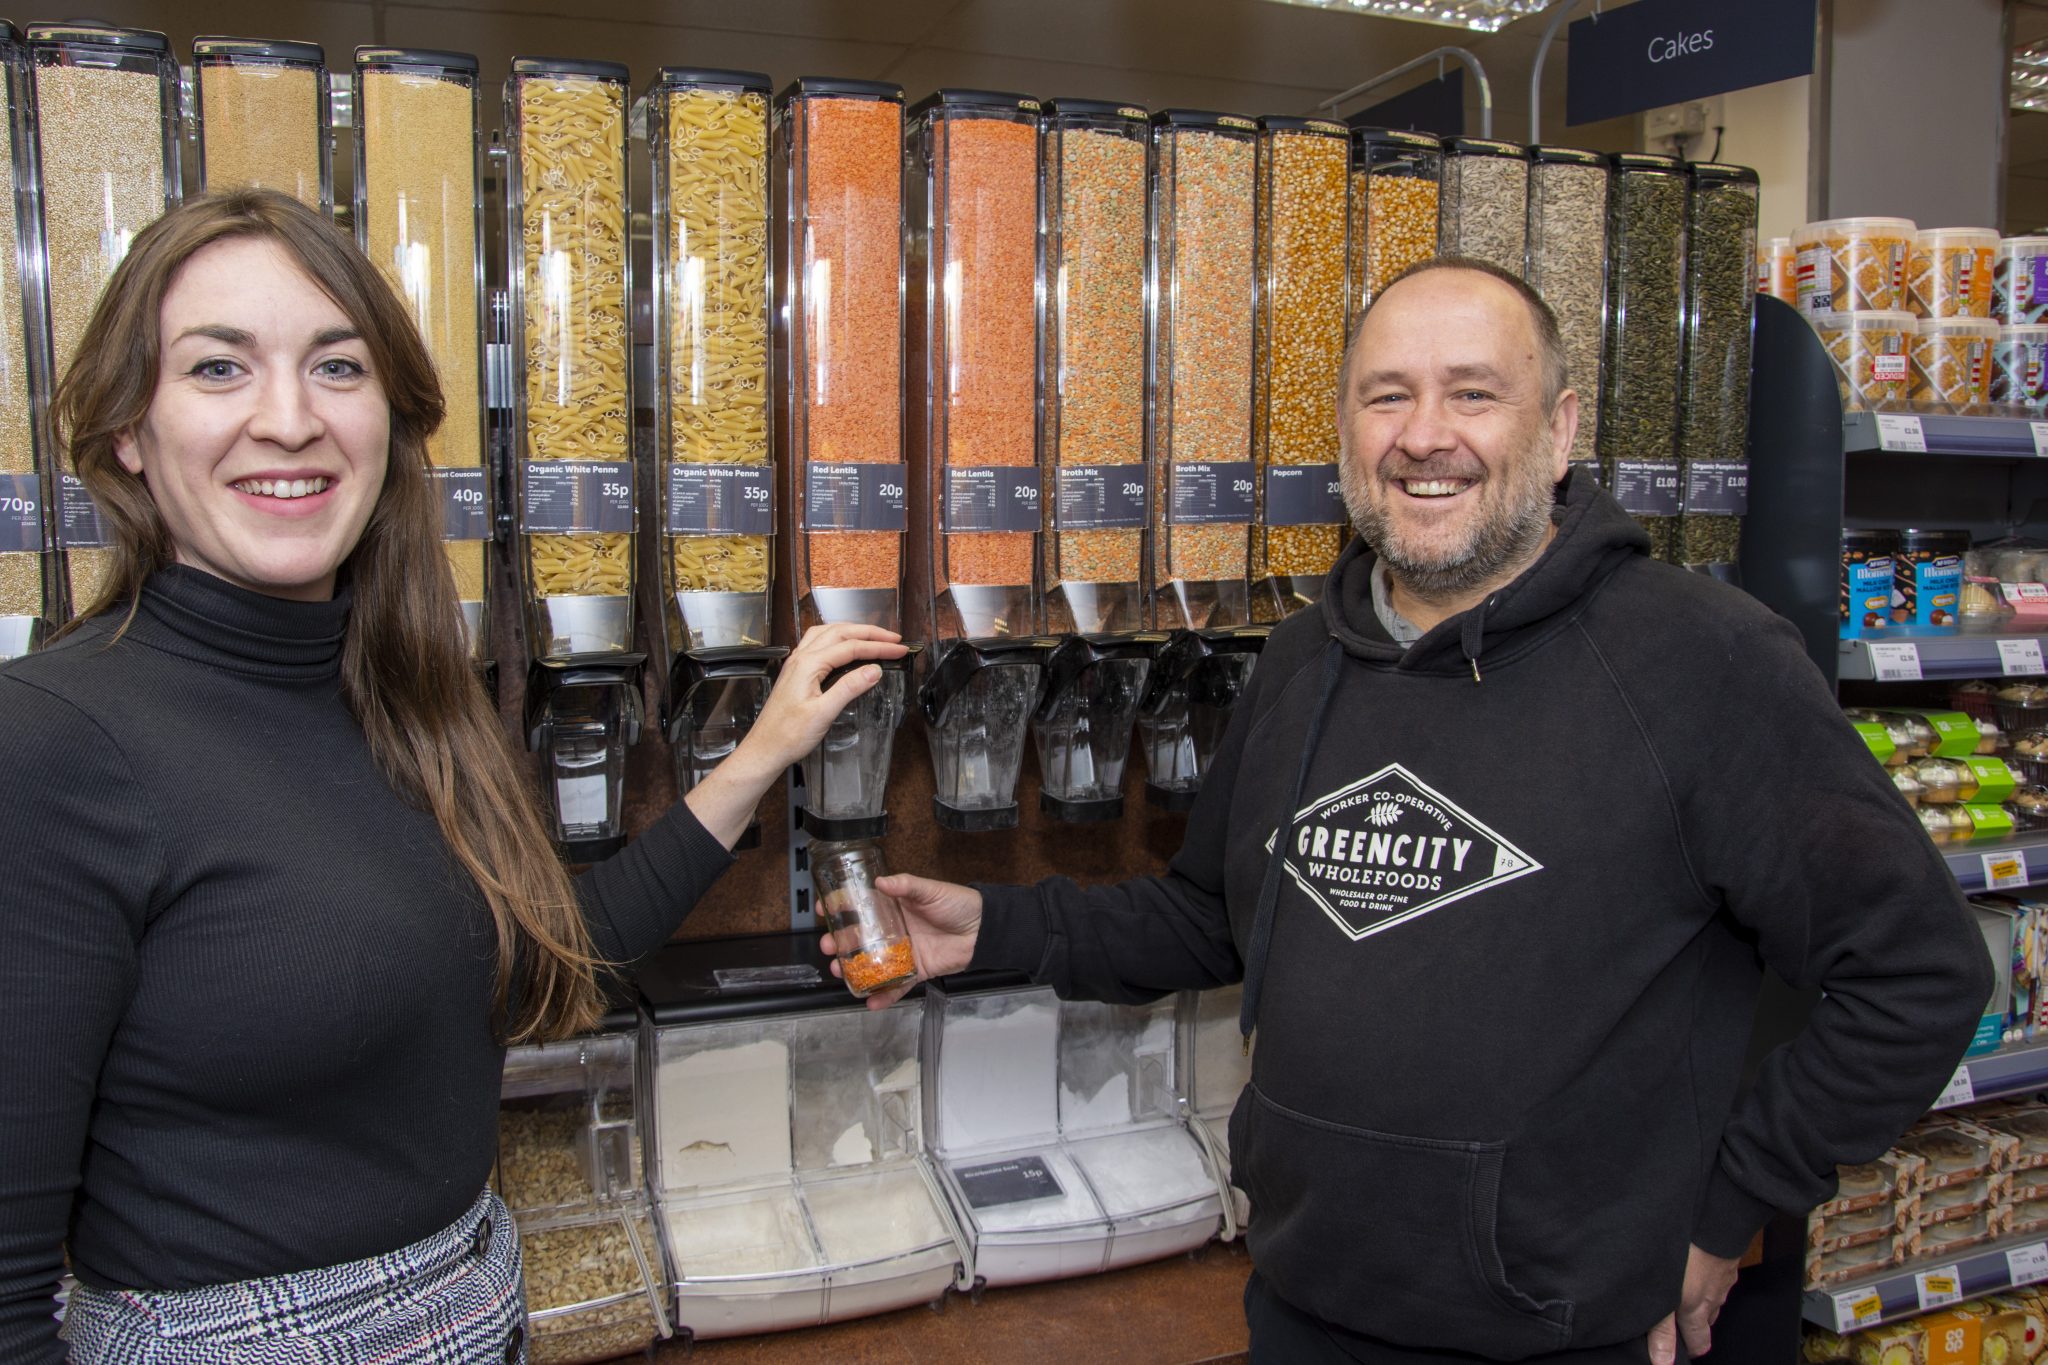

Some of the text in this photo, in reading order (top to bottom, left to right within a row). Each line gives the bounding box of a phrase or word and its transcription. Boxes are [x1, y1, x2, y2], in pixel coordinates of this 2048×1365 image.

[1648, 27, 1714, 63] Cakes
[528, 465, 618, 474] Organic White Penne
[673, 468, 759, 477] Organic White Penne
[812, 466, 857, 474] Red Lentils
[1272, 469, 1303, 477] Popcorn
[1619, 462, 1642, 470] Organic
[1643, 463, 1665, 471] Pumpkin
[1715, 463, 1735, 471] Pumpkin
[968, 470, 994, 478] Lentils
[1233, 480, 1253, 493] 20p
[1656, 477, 1676, 487] £1.00
[1728, 477, 1747, 487] £1.00
[602, 483, 629, 498] 35p
[744, 487, 768, 502] 35p
[879, 484, 903, 498] 20p
[1014, 486, 1037, 500] 20p
[1122, 483, 1144, 496] 20p
[453, 489, 483, 504] 40p
[0, 498, 35, 514] 70p
[1320, 791, 1452, 832] WORKER CO-OPERATIVE
[1298, 825, 1472, 872] GREENCITY
[1308, 862, 1442, 891] WHOLEFOODS
[1329, 888, 1409, 904] WHOLESALER OF FINE
[1339, 899, 1393, 912] FOOD & DRINK
[964, 1167, 1002, 1178] Bicarbonate
[1022, 1169, 1043, 1178] 15p
